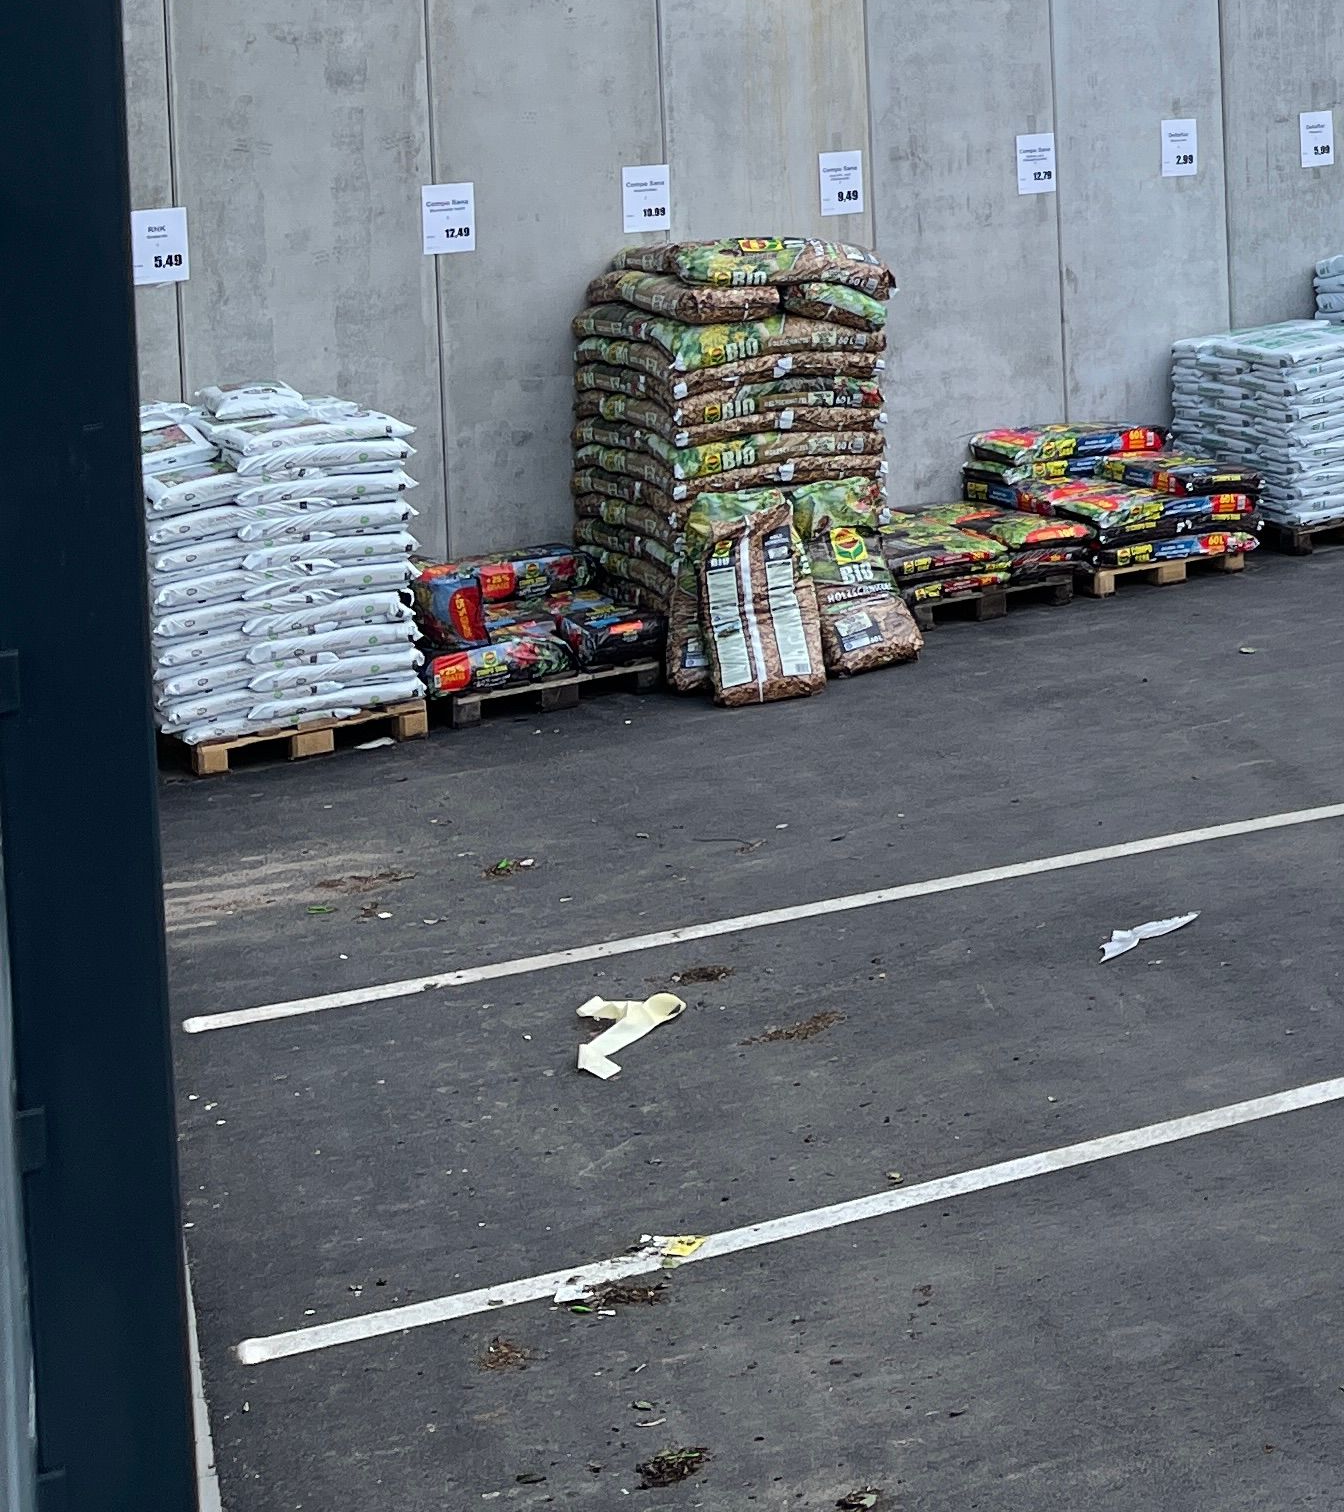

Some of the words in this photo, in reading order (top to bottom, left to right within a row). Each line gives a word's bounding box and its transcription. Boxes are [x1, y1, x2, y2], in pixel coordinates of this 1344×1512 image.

[837, 189, 858, 202] 9,49
[445, 227, 470, 238] 12,49
[153, 253, 182, 268] 5,49
[725, 338, 759, 361] BIO
[722, 397, 756, 420] BIO
[721, 446, 756, 470] BIO
[839, 562, 874, 584] BIO
